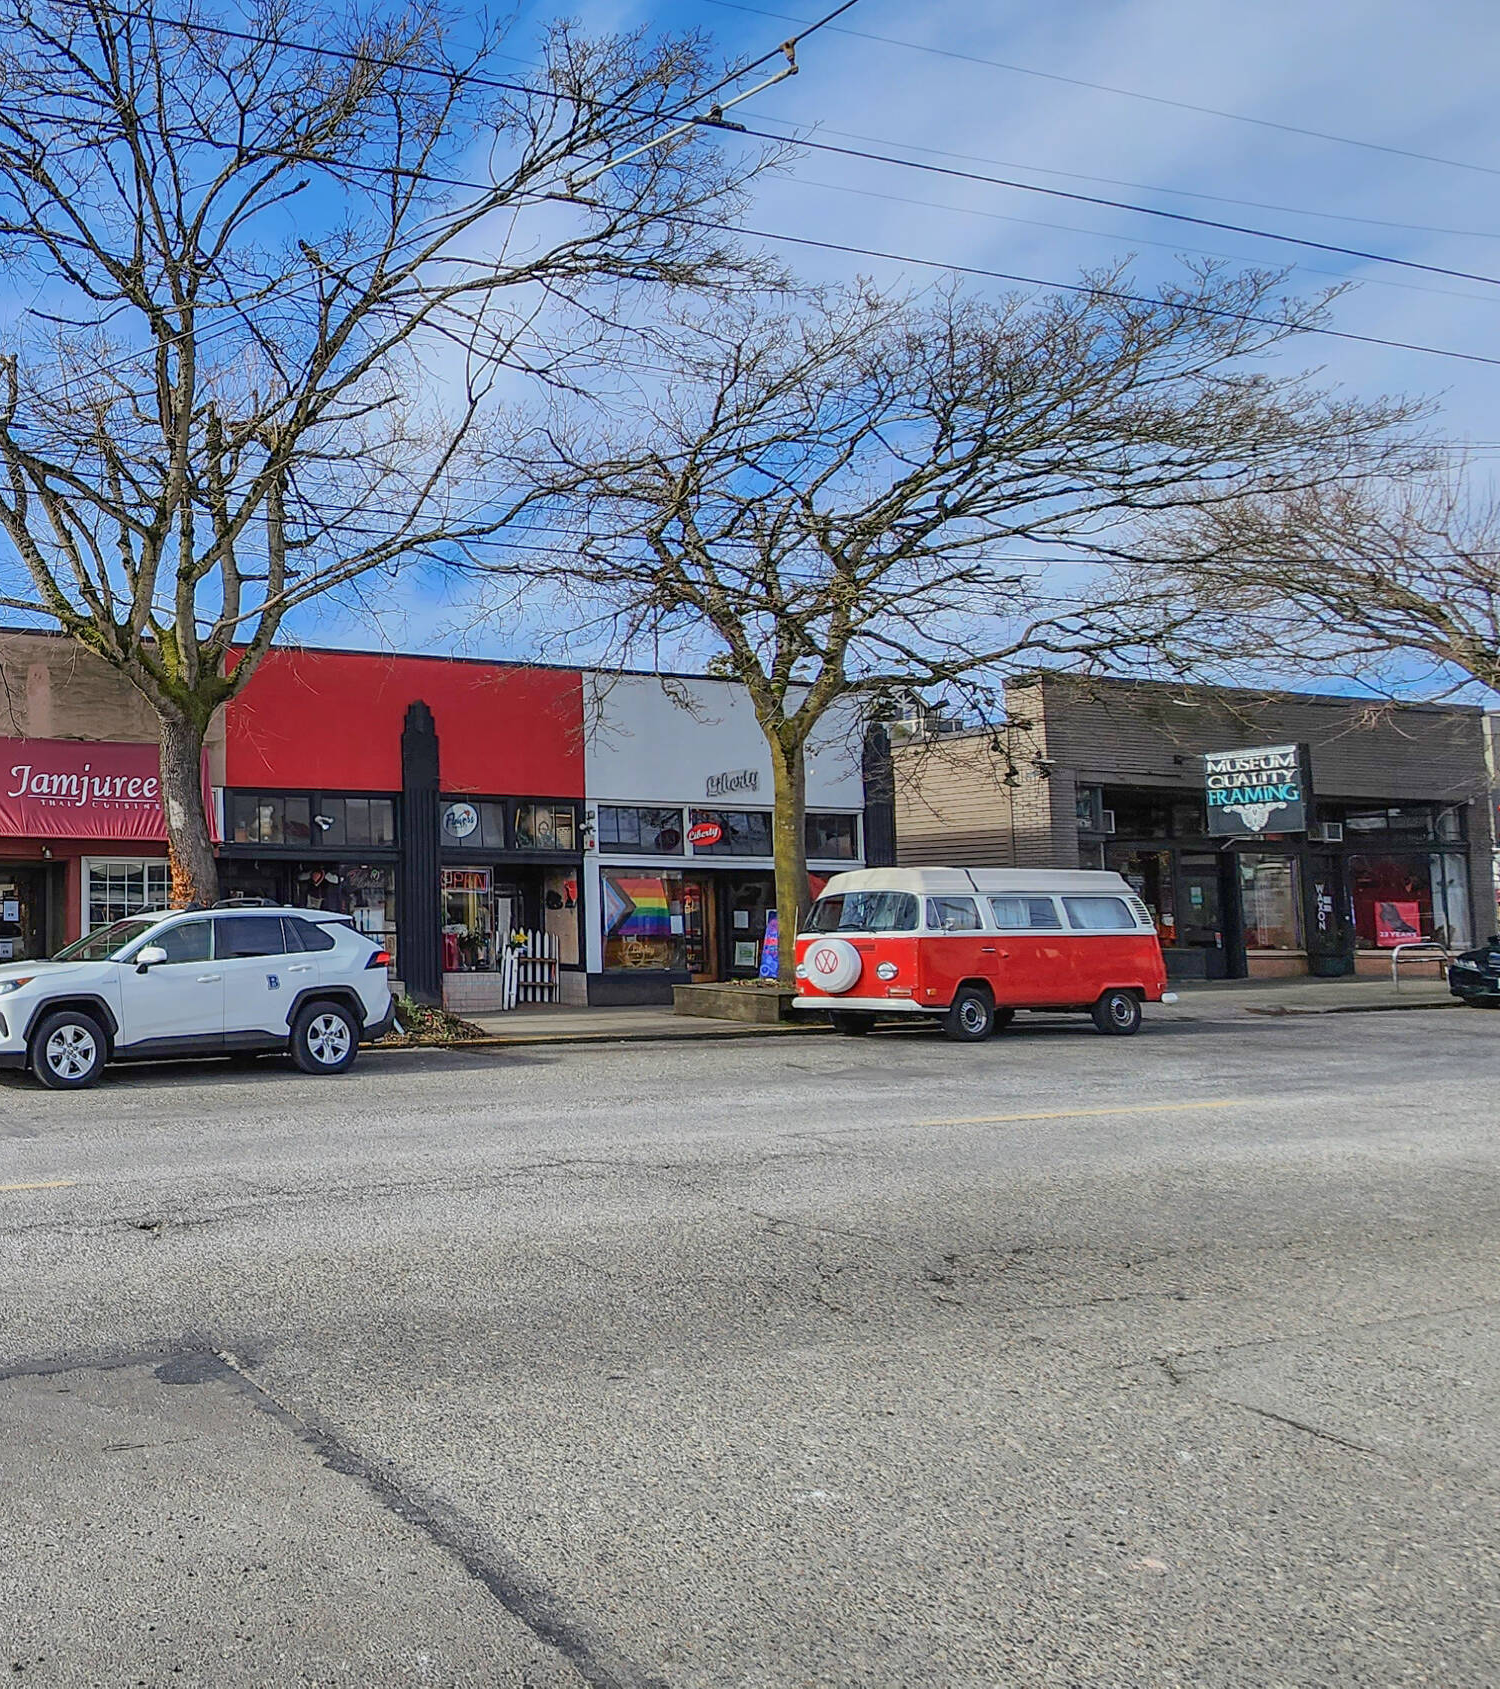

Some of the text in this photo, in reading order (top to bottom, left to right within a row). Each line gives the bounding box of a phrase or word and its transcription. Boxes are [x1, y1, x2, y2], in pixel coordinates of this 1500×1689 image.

[1206, 753, 1298, 775] MUSEUM
[7, 764, 158, 807] Jamjuree
[1207, 768, 1298, 789] QUALITY
[40, 799, 72, 807] THAI
[1207, 783, 1301, 806] FRAMING
[689, 827, 719, 842] Liberty
